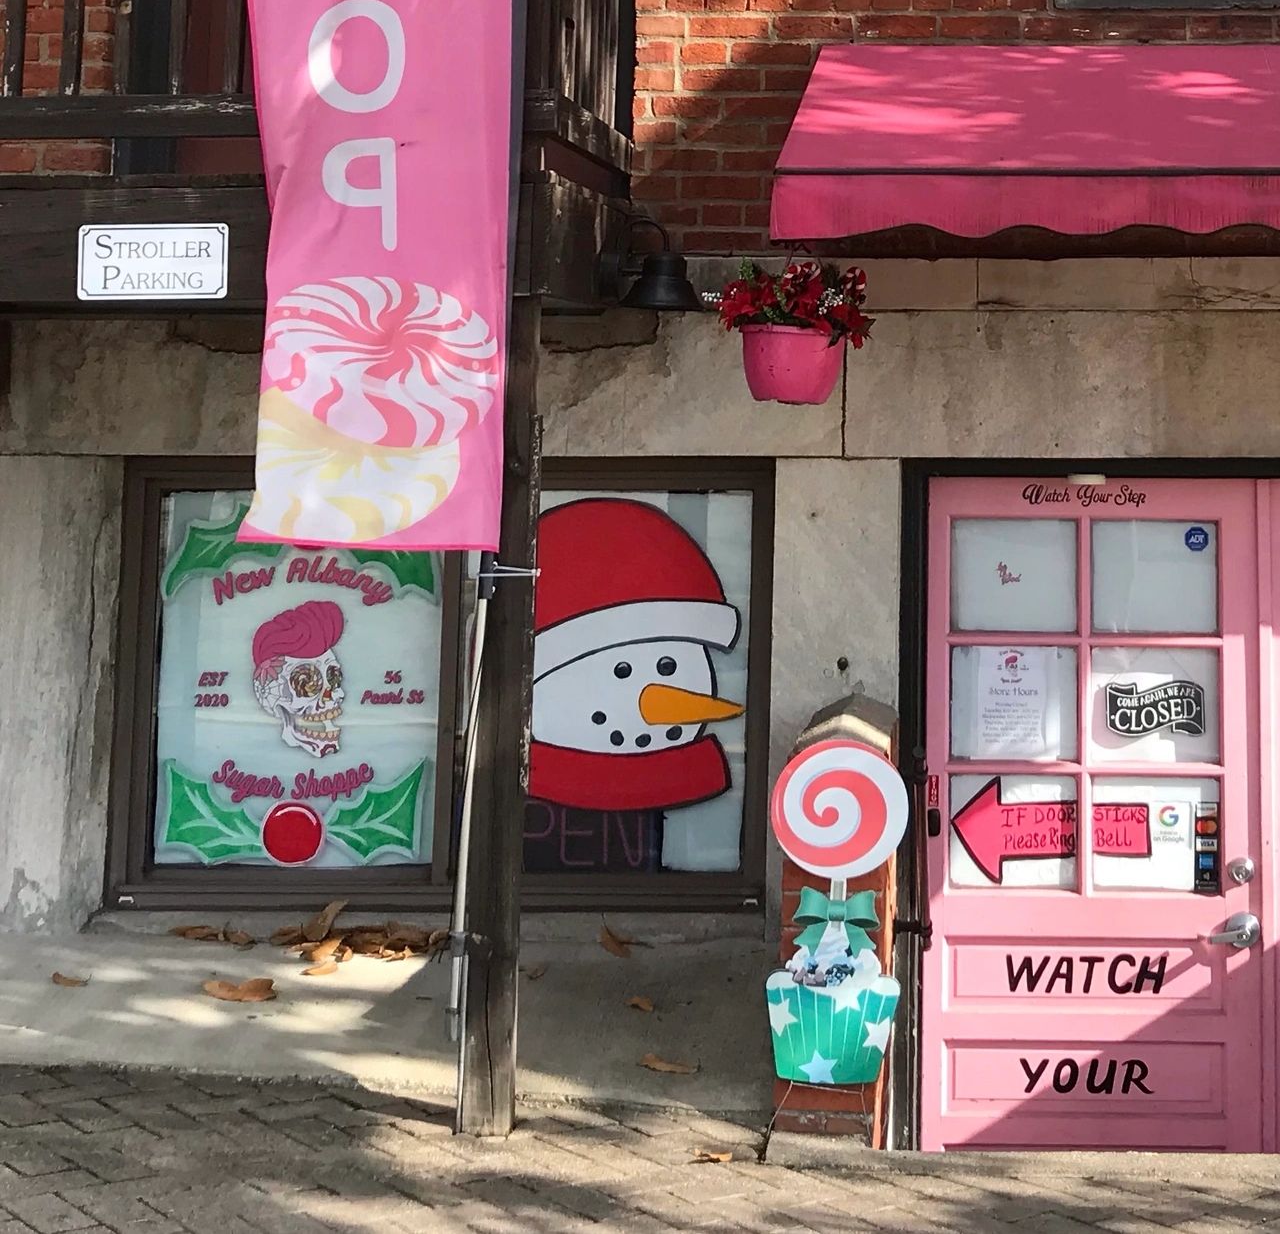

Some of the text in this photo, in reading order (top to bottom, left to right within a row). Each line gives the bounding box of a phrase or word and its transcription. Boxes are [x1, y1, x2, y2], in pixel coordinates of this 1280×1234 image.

[95, 234, 212, 259] STROLLER
[102, 265, 203, 290] PARKING
[1022, 484, 1146, 507] Watch Your Step
[1189, 534, 1205, 544] ADT
[212, 556, 393, 606] New Albany
[198, 671, 229, 687] EST
[384, 670, 402, 685] 56
[194, 693, 229, 707] 2020
[406, 689, 425, 704] St
[1117, 697, 1139, 707] COME
[1167, 686, 1179, 696] WE
[1180, 687, 1196, 697] ARE
[1115, 698, 1197, 731] CLOSED
[212, 760, 374, 802] Sugar Shoppe
[1001, 807, 1146, 828] IF DOOR STICKS
[1004, 828, 1132, 852] Please Ring Bell
[1006, 954, 1167, 994] WATCH
[1019, 1058, 1155, 1095] YOUR
